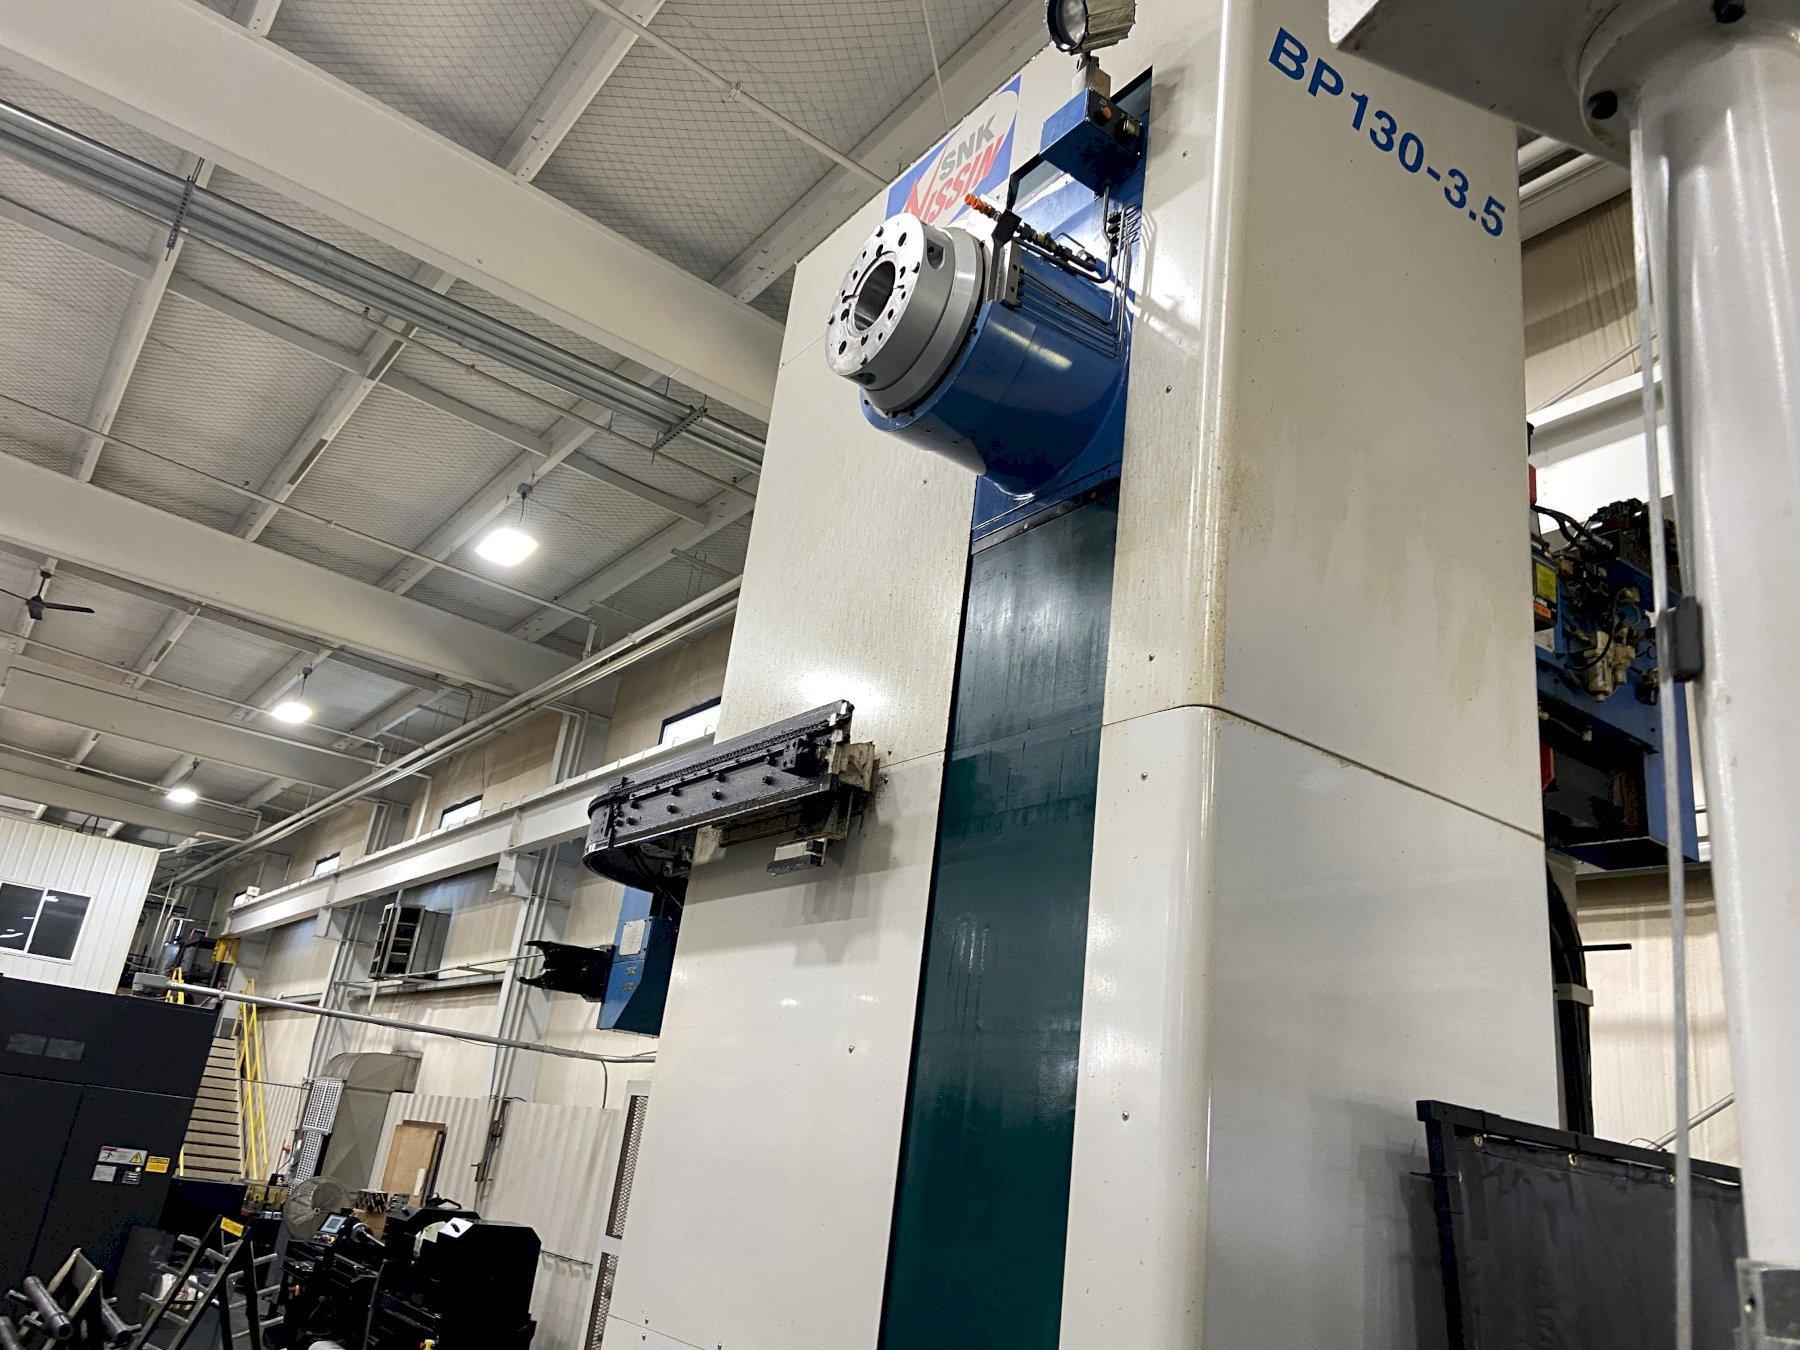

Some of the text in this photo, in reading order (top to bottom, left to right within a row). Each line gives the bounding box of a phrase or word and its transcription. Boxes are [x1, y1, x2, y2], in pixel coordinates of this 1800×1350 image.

[939, 113, 996, 181] SNK
[1268, 27, 1506, 237] BP130-3.5
[903, 133, 1005, 224] NISSIN
